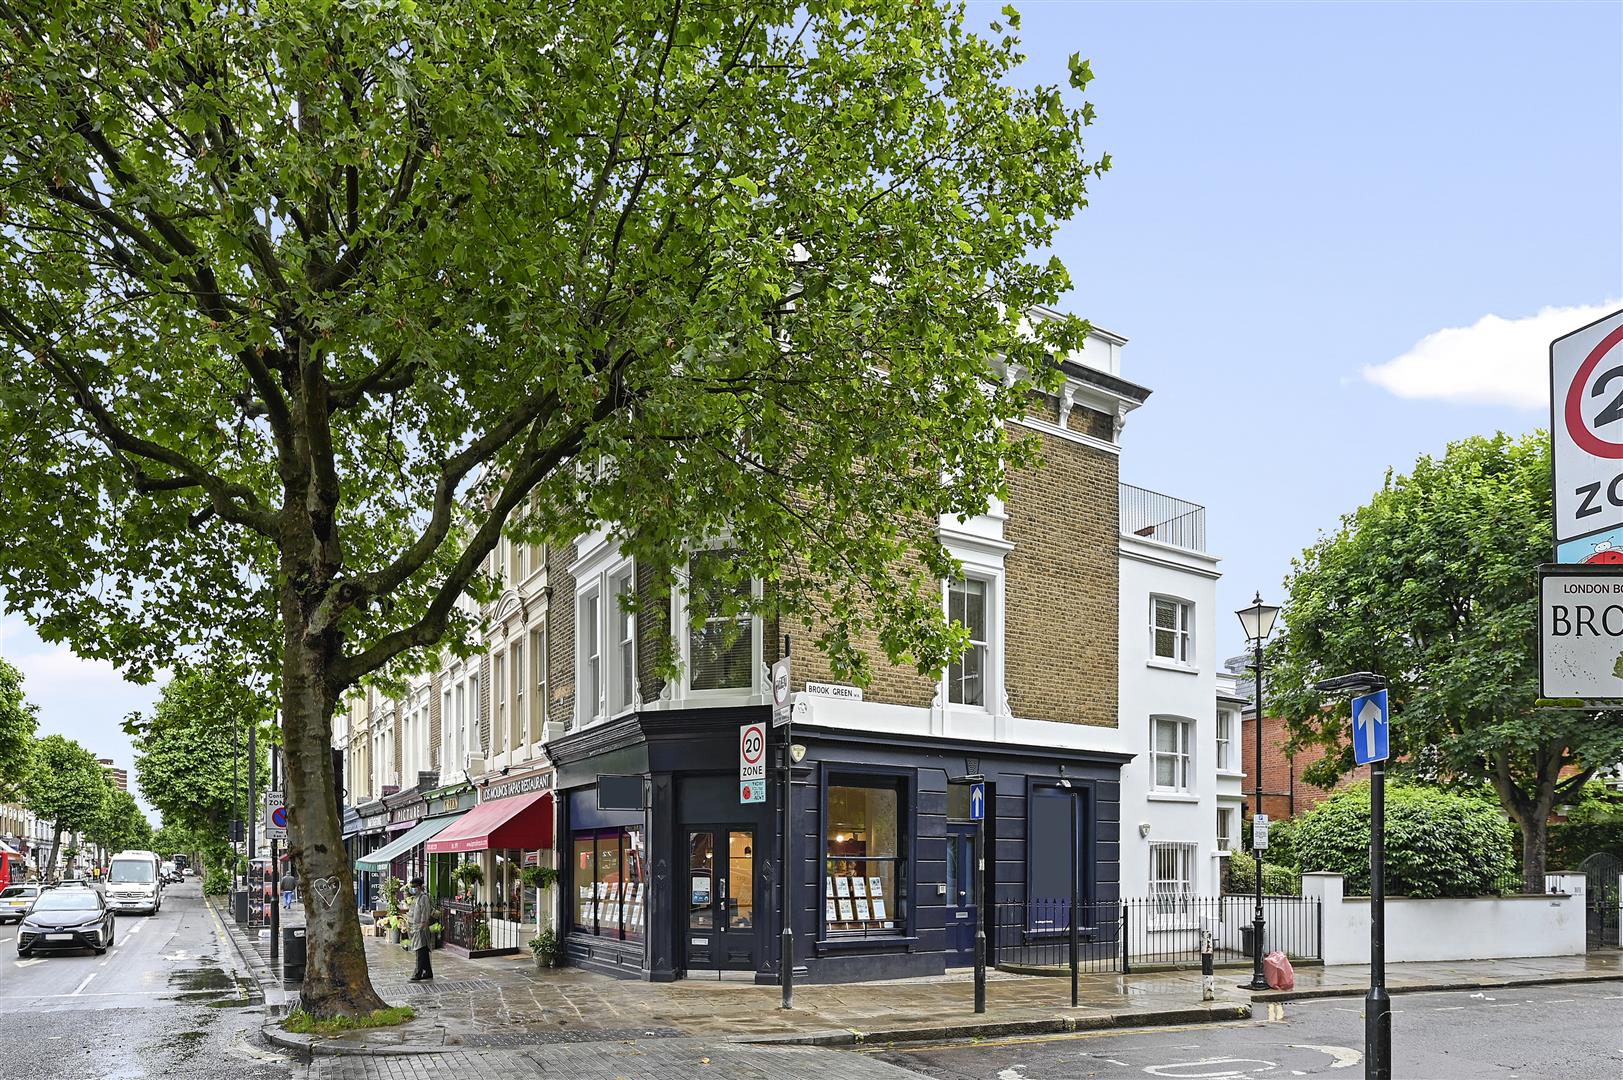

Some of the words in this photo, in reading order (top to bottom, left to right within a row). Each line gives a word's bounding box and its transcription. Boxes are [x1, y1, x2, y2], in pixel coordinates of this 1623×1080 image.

[1591, 364, 1623, 428] 2
[1563, 584, 1610, 594] LONDON
[808, 685, 830, 695] BROOK
[832, 687, 853, 697] GREEN
[745, 737, 761, 753] 20
[742, 765, 763, 776] ZONE
[508, 780, 521, 795] TAPAS
[521, 774, 550, 792] RESTAURANT
[397, 805, 420, 821] PICTURE
[317, 882, 336, 891] LOVE
